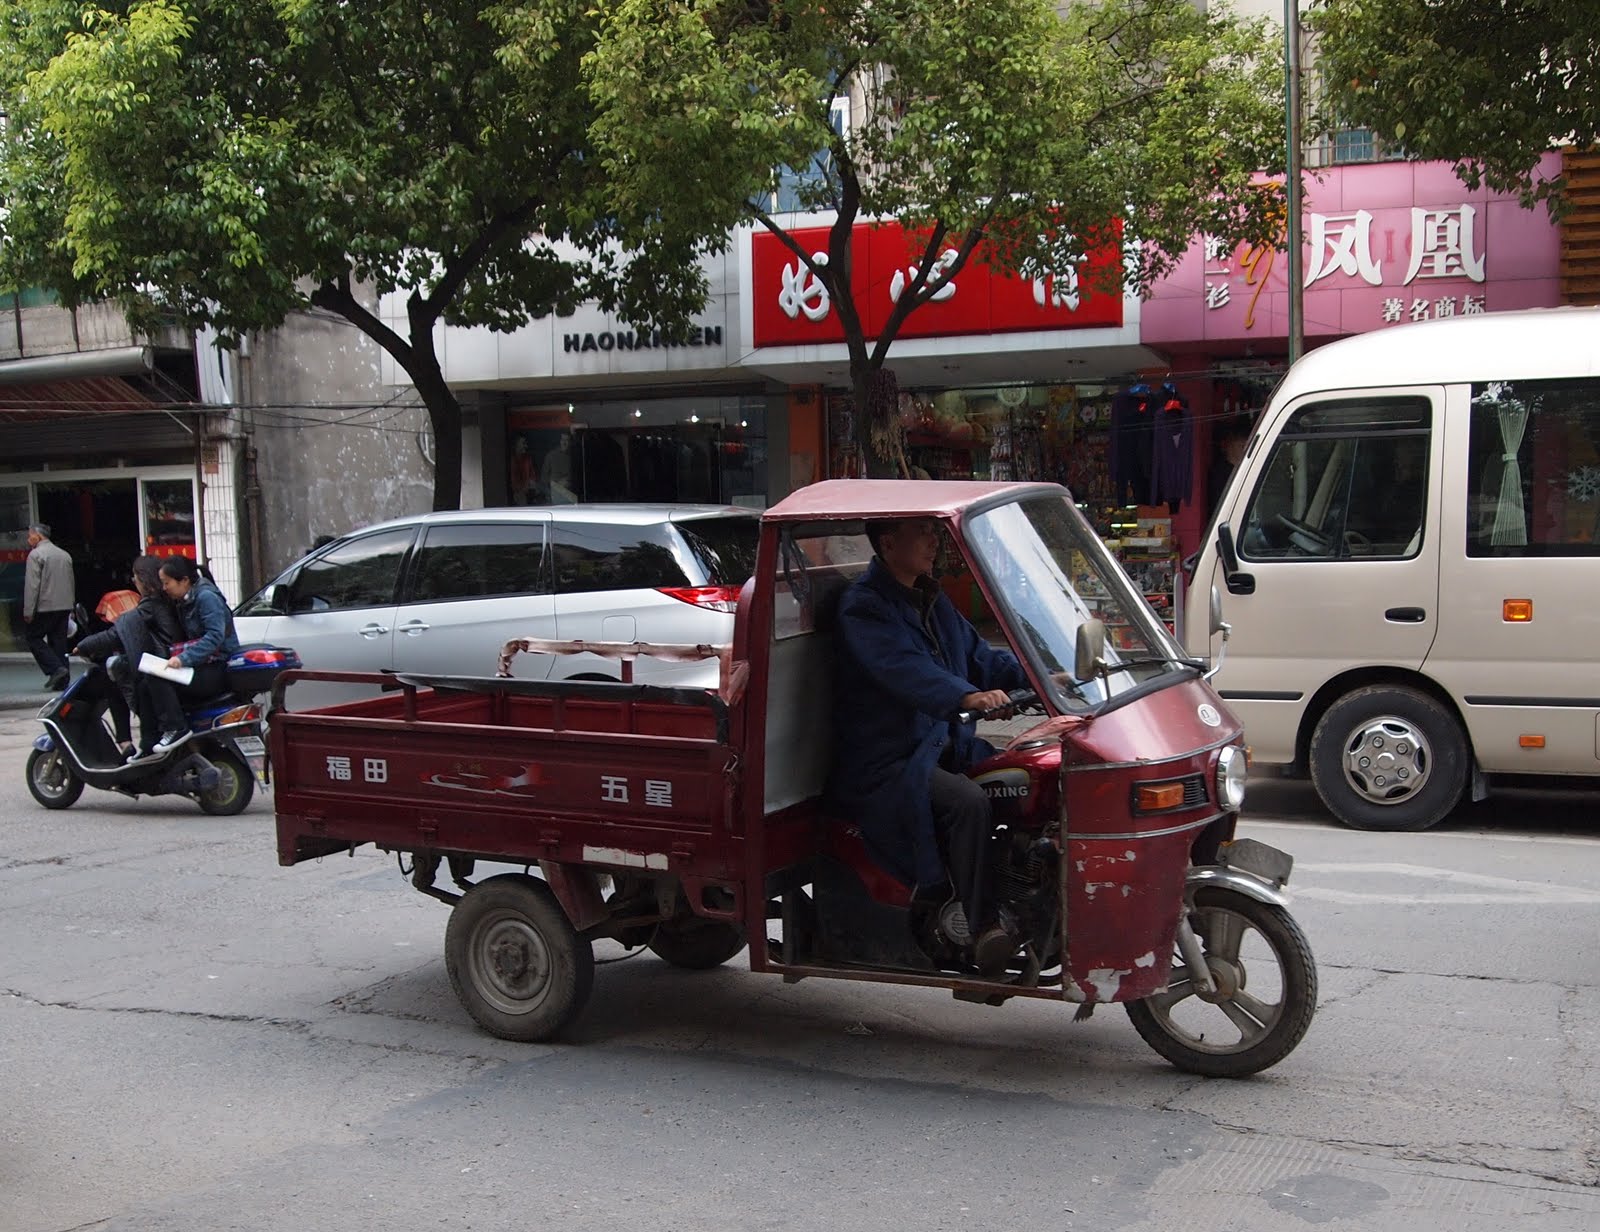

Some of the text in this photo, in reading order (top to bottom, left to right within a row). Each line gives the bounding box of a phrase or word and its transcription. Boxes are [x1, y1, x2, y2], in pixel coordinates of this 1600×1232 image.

[1303, 203, 1486, 289] 凤凰
[1382, 294, 1486, 321] 著名商标
[563, 325, 722, 353] HAONAEN
[326, 755, 673, 807] 福田 五星
